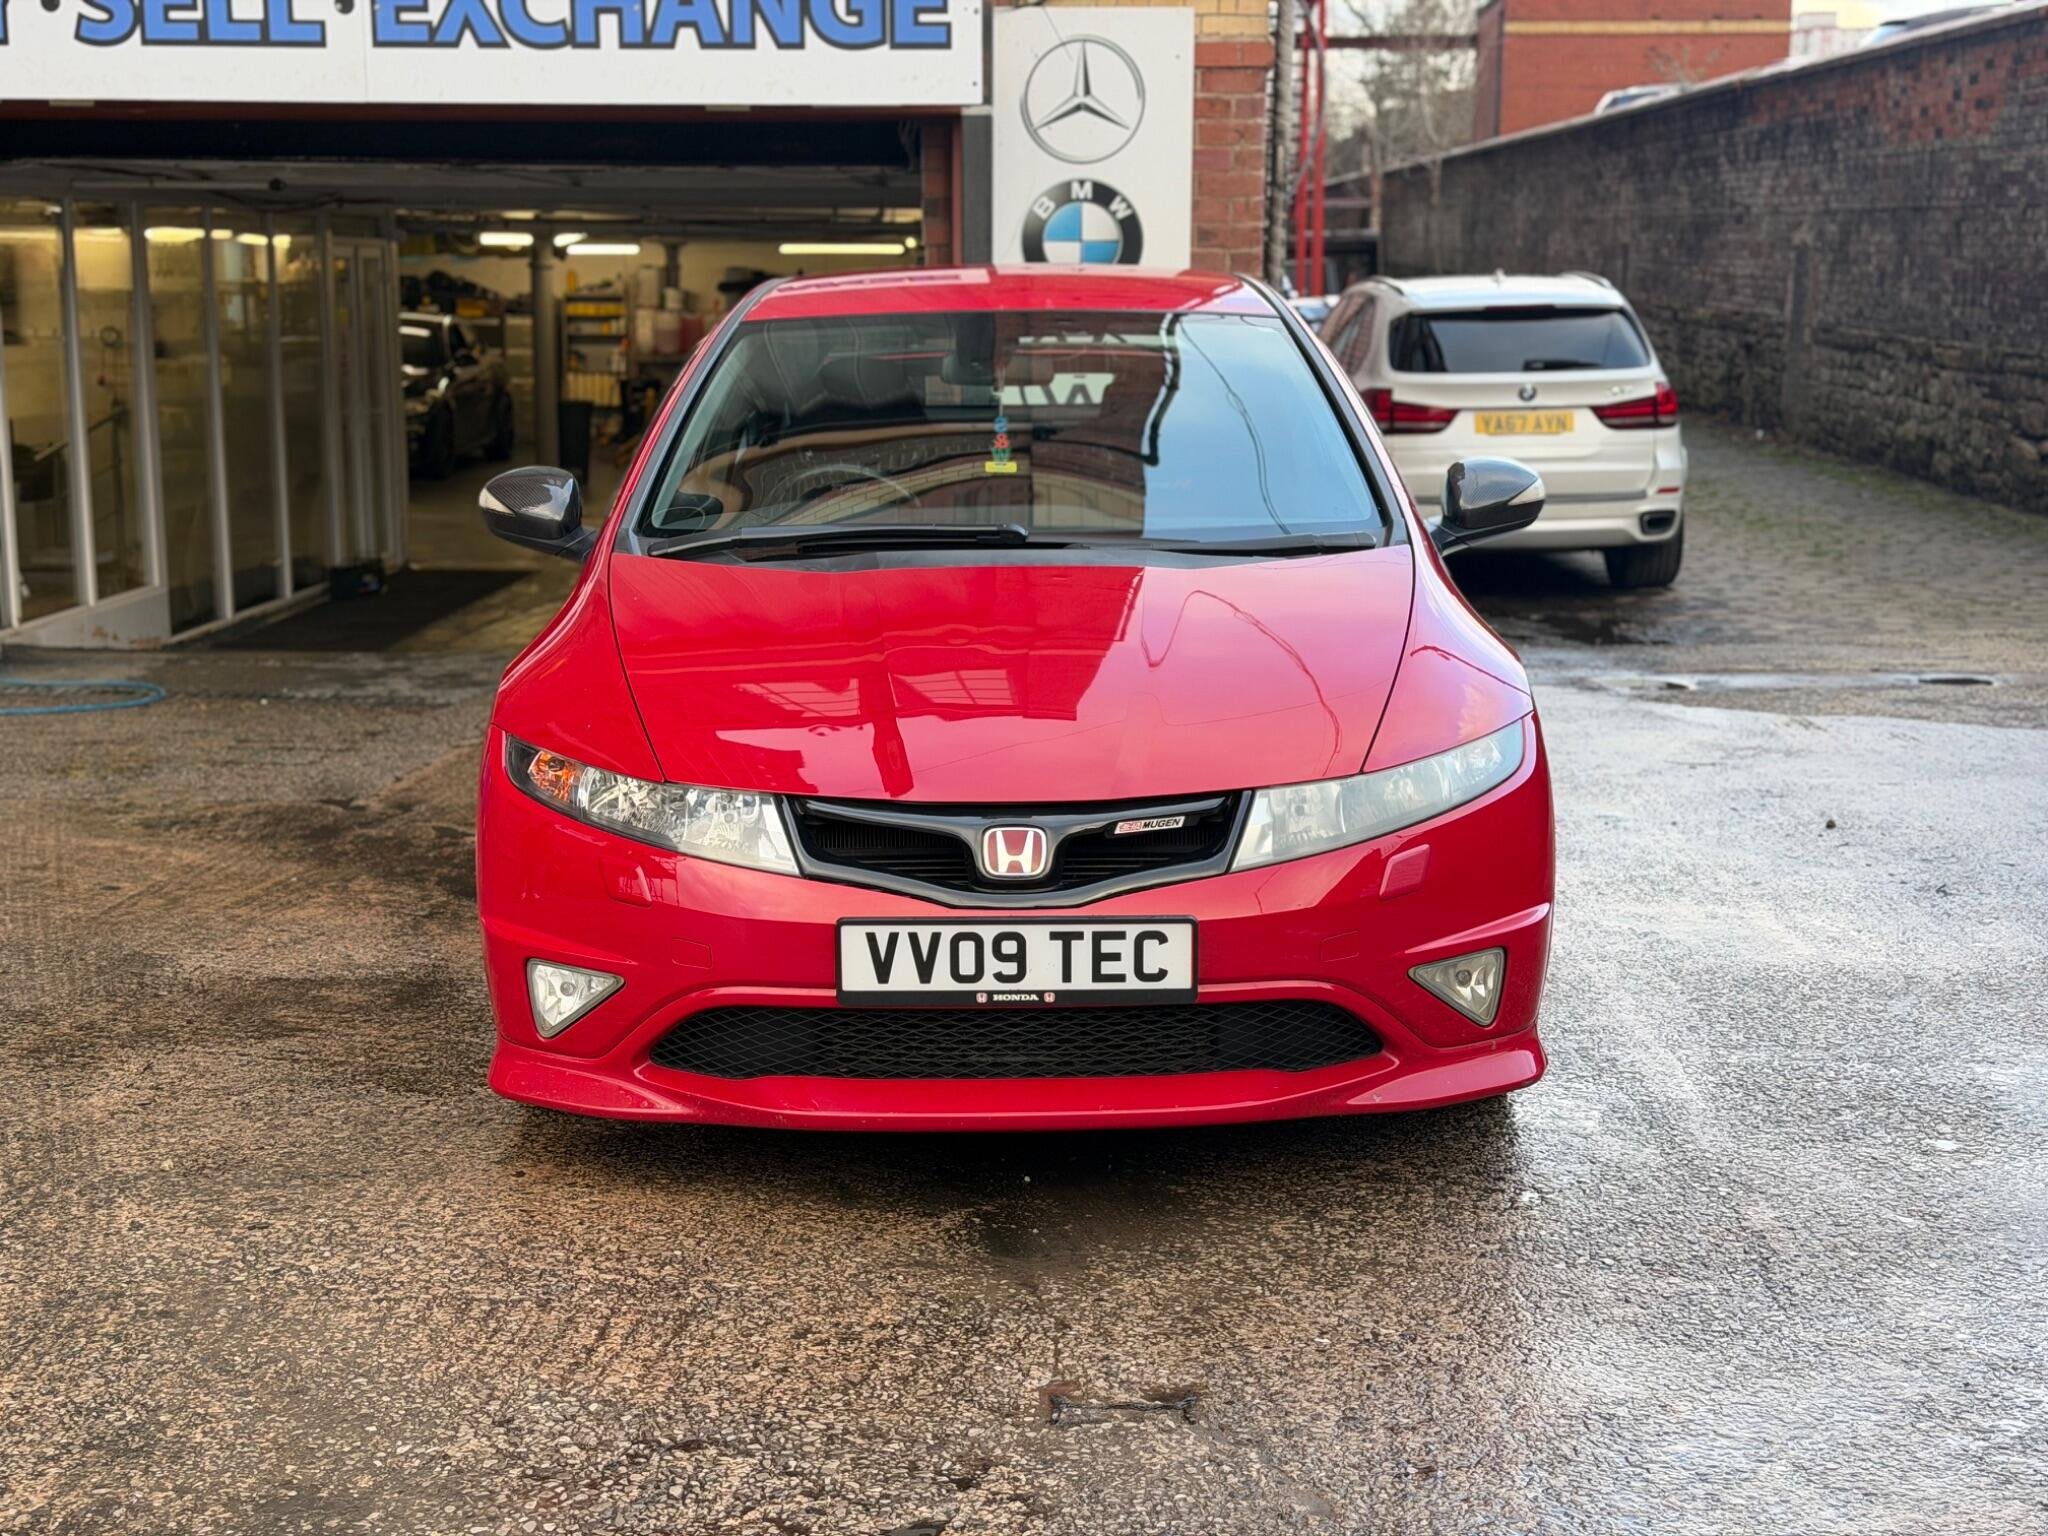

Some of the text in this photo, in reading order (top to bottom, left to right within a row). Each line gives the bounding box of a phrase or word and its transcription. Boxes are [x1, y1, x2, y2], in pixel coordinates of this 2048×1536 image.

[1033, 180, 1132, 220] BMW
[1142, 819, 1181, 829] MUGEN
[865, 930, 1169, 985] VV09 TEC
[992, 993, 1039, 1001] HONDA
